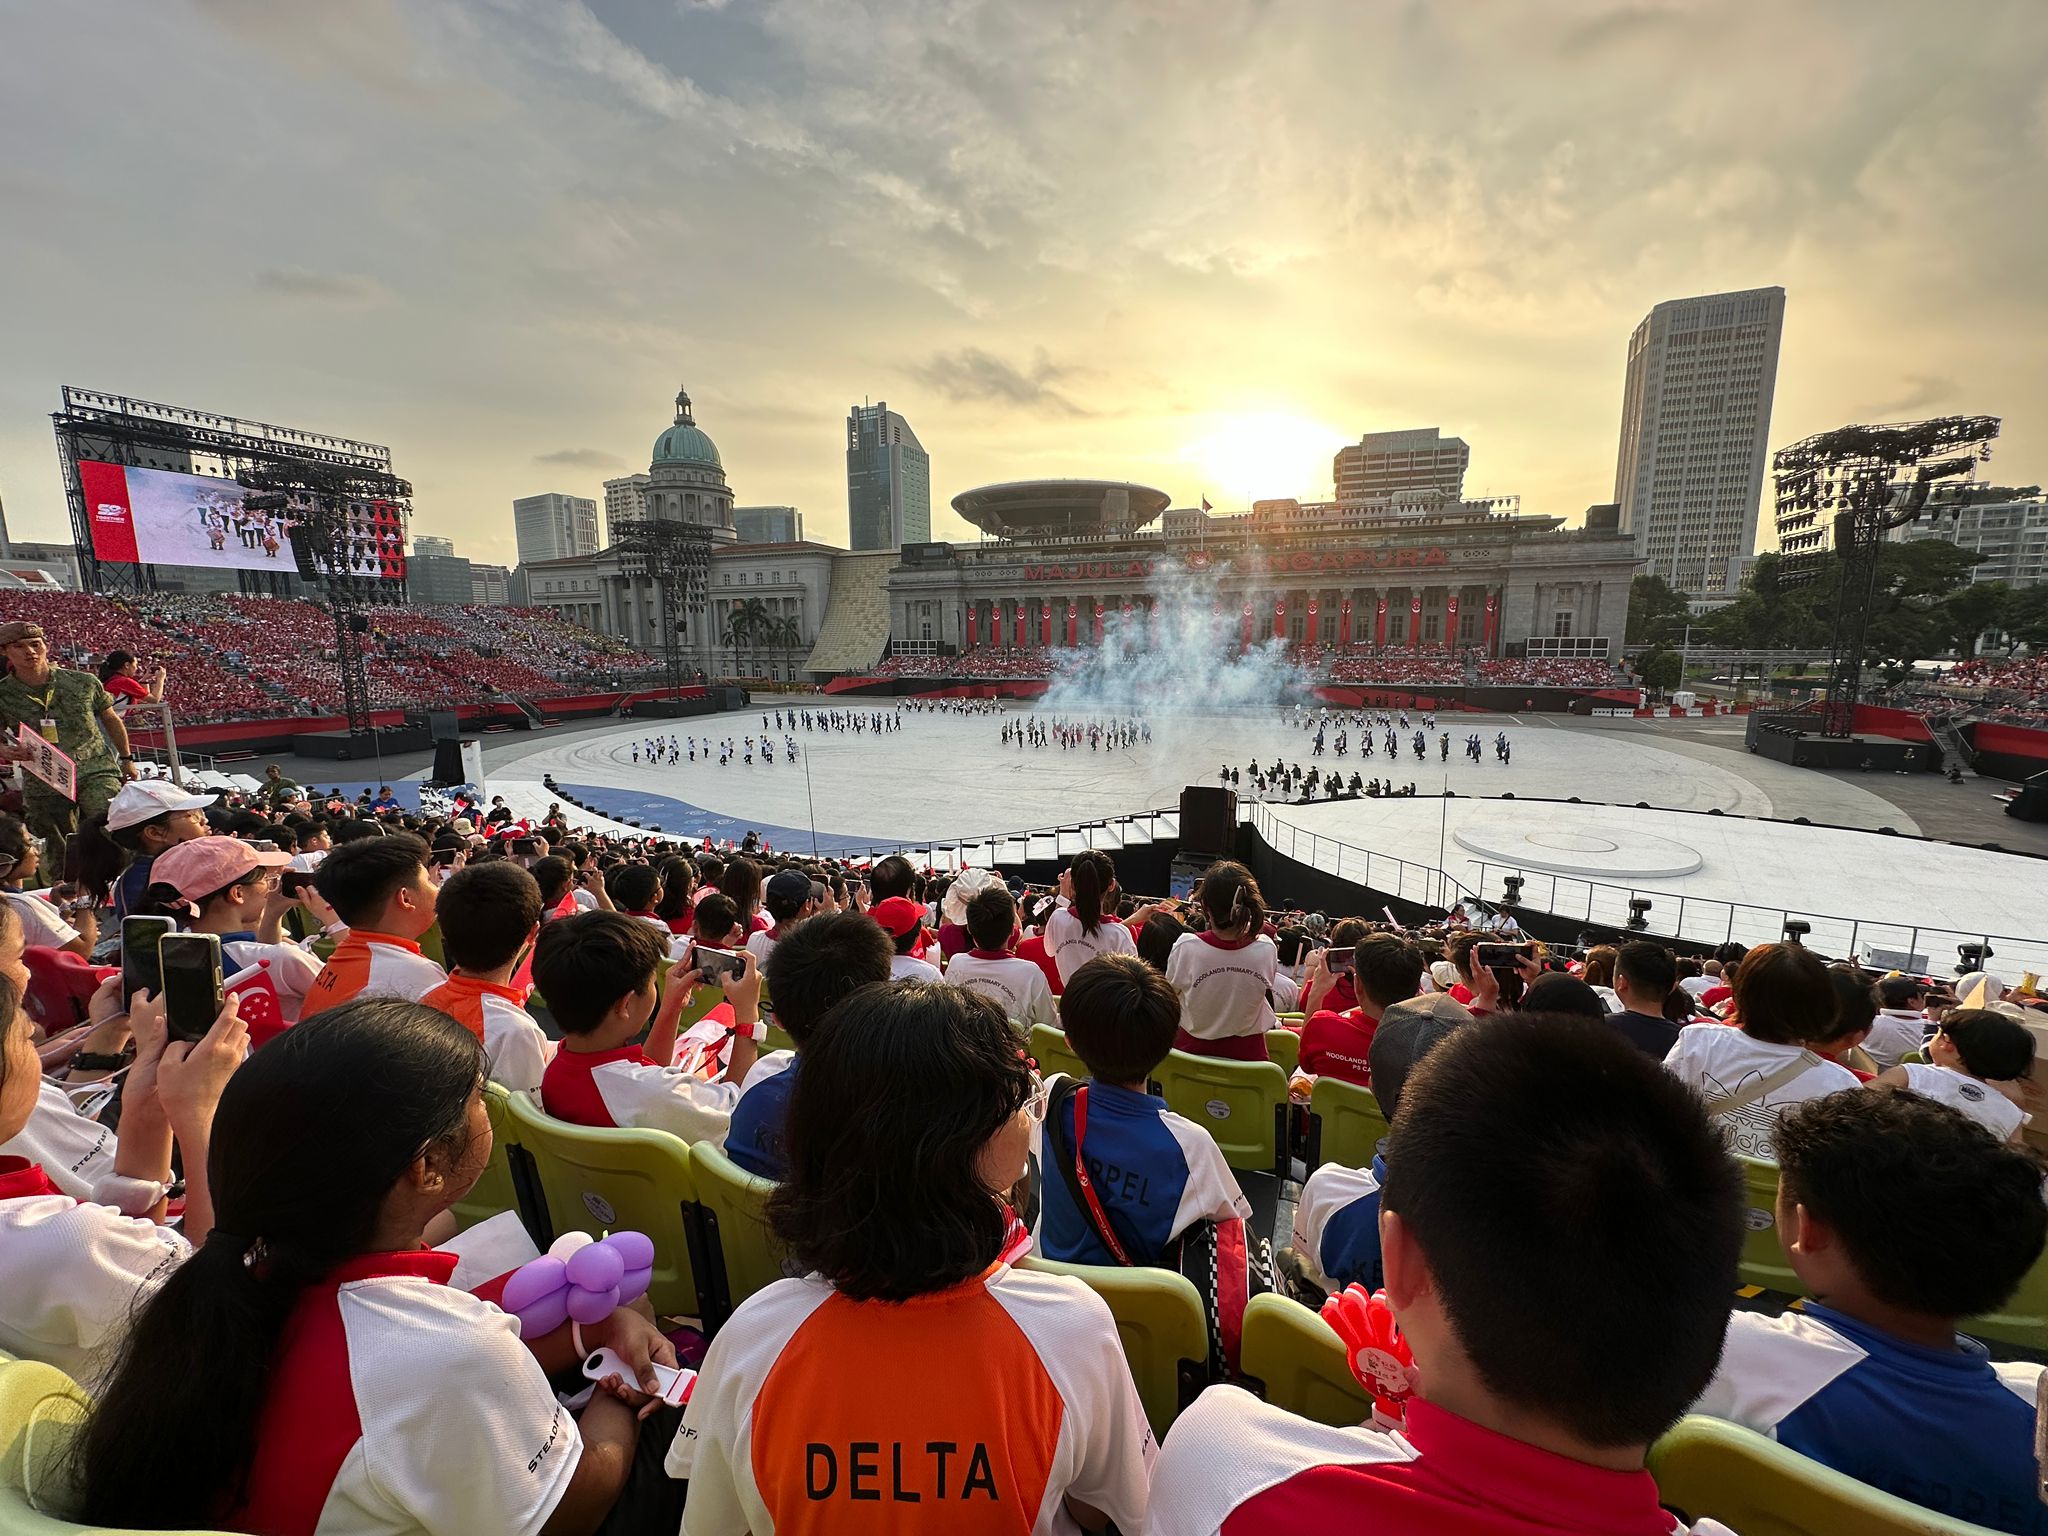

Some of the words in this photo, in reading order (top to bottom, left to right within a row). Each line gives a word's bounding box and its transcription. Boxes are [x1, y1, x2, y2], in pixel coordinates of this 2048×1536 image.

[315, 964, 338, 992] LTA
[978, 977, 1001, 987] PRIMARY
[1193, 966, 1225, 988] WOODLANDS
[1226, 966, 1254, 975] PRIMARY
[1325, 1050, 1367, 1065] WOODLANDS
[71, 1129, 108, 1173] STEADFAST
[1089, 1157, 1151, 1207] PPEL
[805, 1441, 1000, 1503] DELTA
